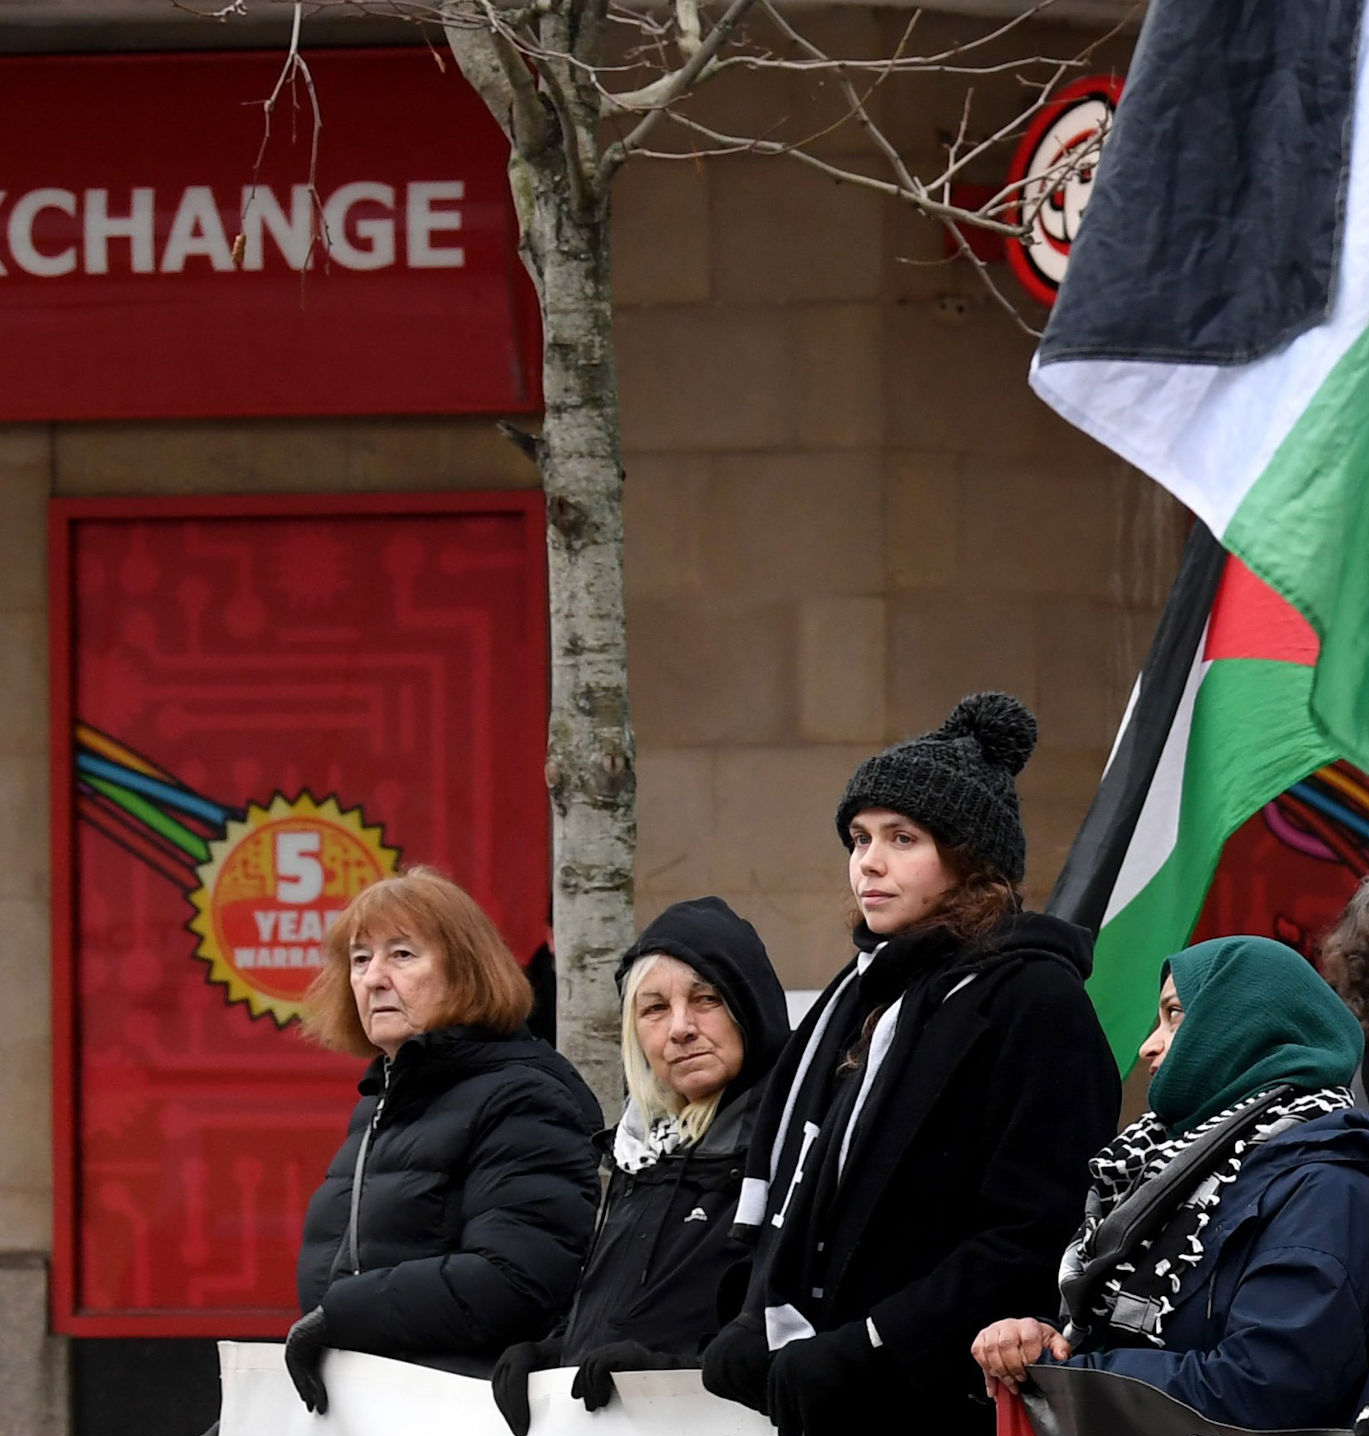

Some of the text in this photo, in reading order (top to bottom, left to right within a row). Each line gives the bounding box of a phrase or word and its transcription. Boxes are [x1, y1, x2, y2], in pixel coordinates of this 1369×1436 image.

[0, 181, 466, 277] CHANGE
[276, 832, 325, 904] 5
[235, 947, 320, 968] WARRA
